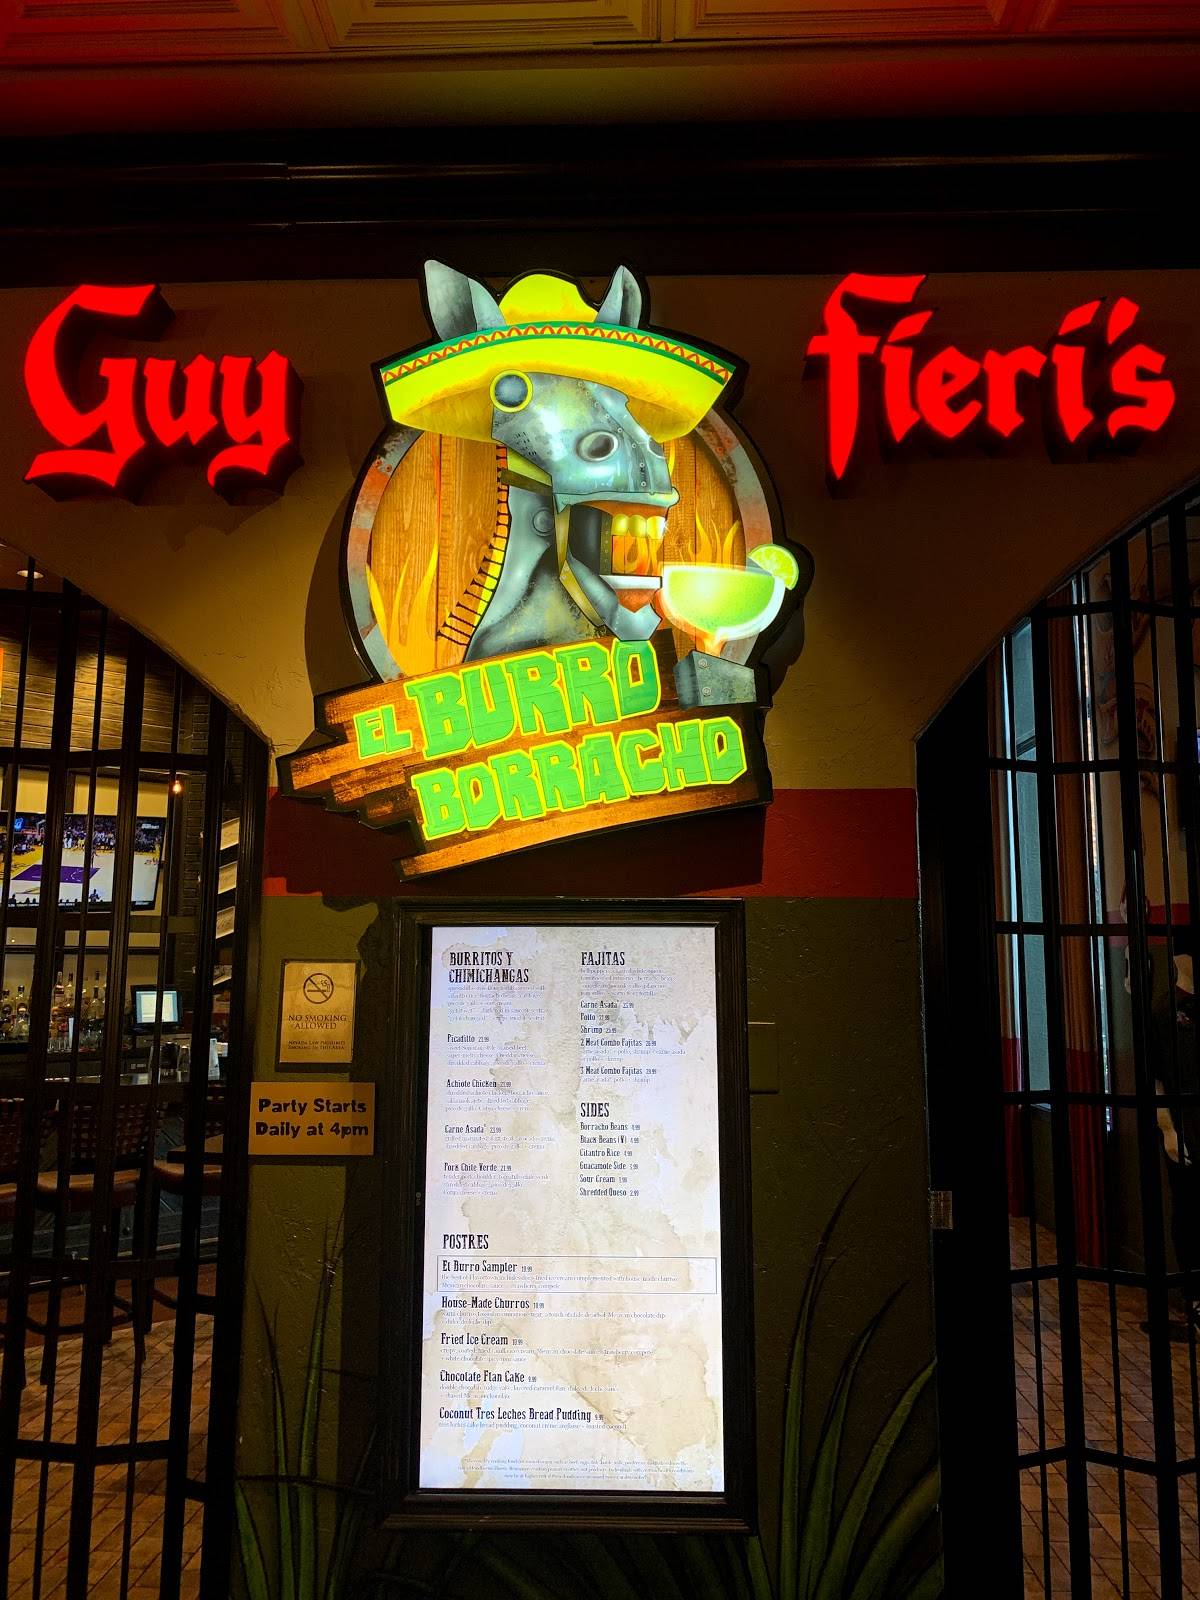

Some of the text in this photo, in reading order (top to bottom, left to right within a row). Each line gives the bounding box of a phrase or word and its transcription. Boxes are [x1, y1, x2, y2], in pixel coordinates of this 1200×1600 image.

[25, 284, 290, 488] Guy
[353, 640, 661, 760] EL BURRO
[411, 716, 747, 841] BORRACHO
[449, 951, 514, 966] BURRITOS Y
[581, 951, 625, 966] FAJITAS
[449, 968, 529, 983] CHIMICHANGAS
[580, 1000, 598, 1009] Carne
[288, 1014, 347, 1022] NO SMOKING
[295, 1022, 337, 1030] ALLOWED
[580, 1025, 603, 1035] Shrimp
[585, 1038, 600, 1047] Meat
[600, 1038, 621, 1047] Combo
[621, 1038, 642, 1048] Fajitas
[585, 1066, 600, 1075] Meat
[600, 1066, 621, 1075] Combo
[621, 1066, 642, 1076] Fajitas
[446, 1079, 471, 1088] Achiote
[472, 1079, 497, 1088] Chicken
[258, 1098, 367, 1116] Party Starts
[580, 1102, 610, 1117] SIDES
[255, 1121, 369, 1139] Daily at 4pm
[444, 1124, 464, 1134] Carne
[580, 1122, 609, 1131] Borracho
[610, 1122, 628, 1131] Beans
[580, 1135, 597, 1144] Black
[598, 1135, 617, 1144] Beans
[579, 1148, 606, 1157] Cilantro
[606, 1148, 620, 1157] Rice
[444, 1162, 458, 1172] Pork
[460, 1162, 477, 1172] Chile
[478, 1163, 498, 1172] Verde
[579, 1161, 613, 1170] Guacamole
[613, 1161, 626, 1170] Side
[579, 1174, 594, 1183] Sour
[595, 1174, 616, 1183] Cream
[579, 1187, 608, 1197] Shredded
[608, 1187, 627, 1197] Queso
[442, 1234, 489, 1250] POSTRES
[442, 1259, 451, 1272] El
[453, 1259, 480, 1272] Burro
[482, 1260, 518, 1274] Sampler
[441, 1296, 492, 1309] House-Made
[494, 1297, 530, 1309] Churros
[440, 1332, 464, 1345] Fried
[466, 1333, 479, 1345] Ice
[480, 1333, 509, 1345] Cream
[439, 1369, 481, 1383] Chocolate
[483, 1370, 502, 1383] Flan
[504, 1370, 525, 1383] Cake
[439, 1406, 474, 1420] Coconut
[475, 1407, 495, 1420] Tres
[497, 1407, 526, 1420] Leches
[528, 1407, 554, 1421] Bread
[556, 1407, 592, 1423] Pudding
